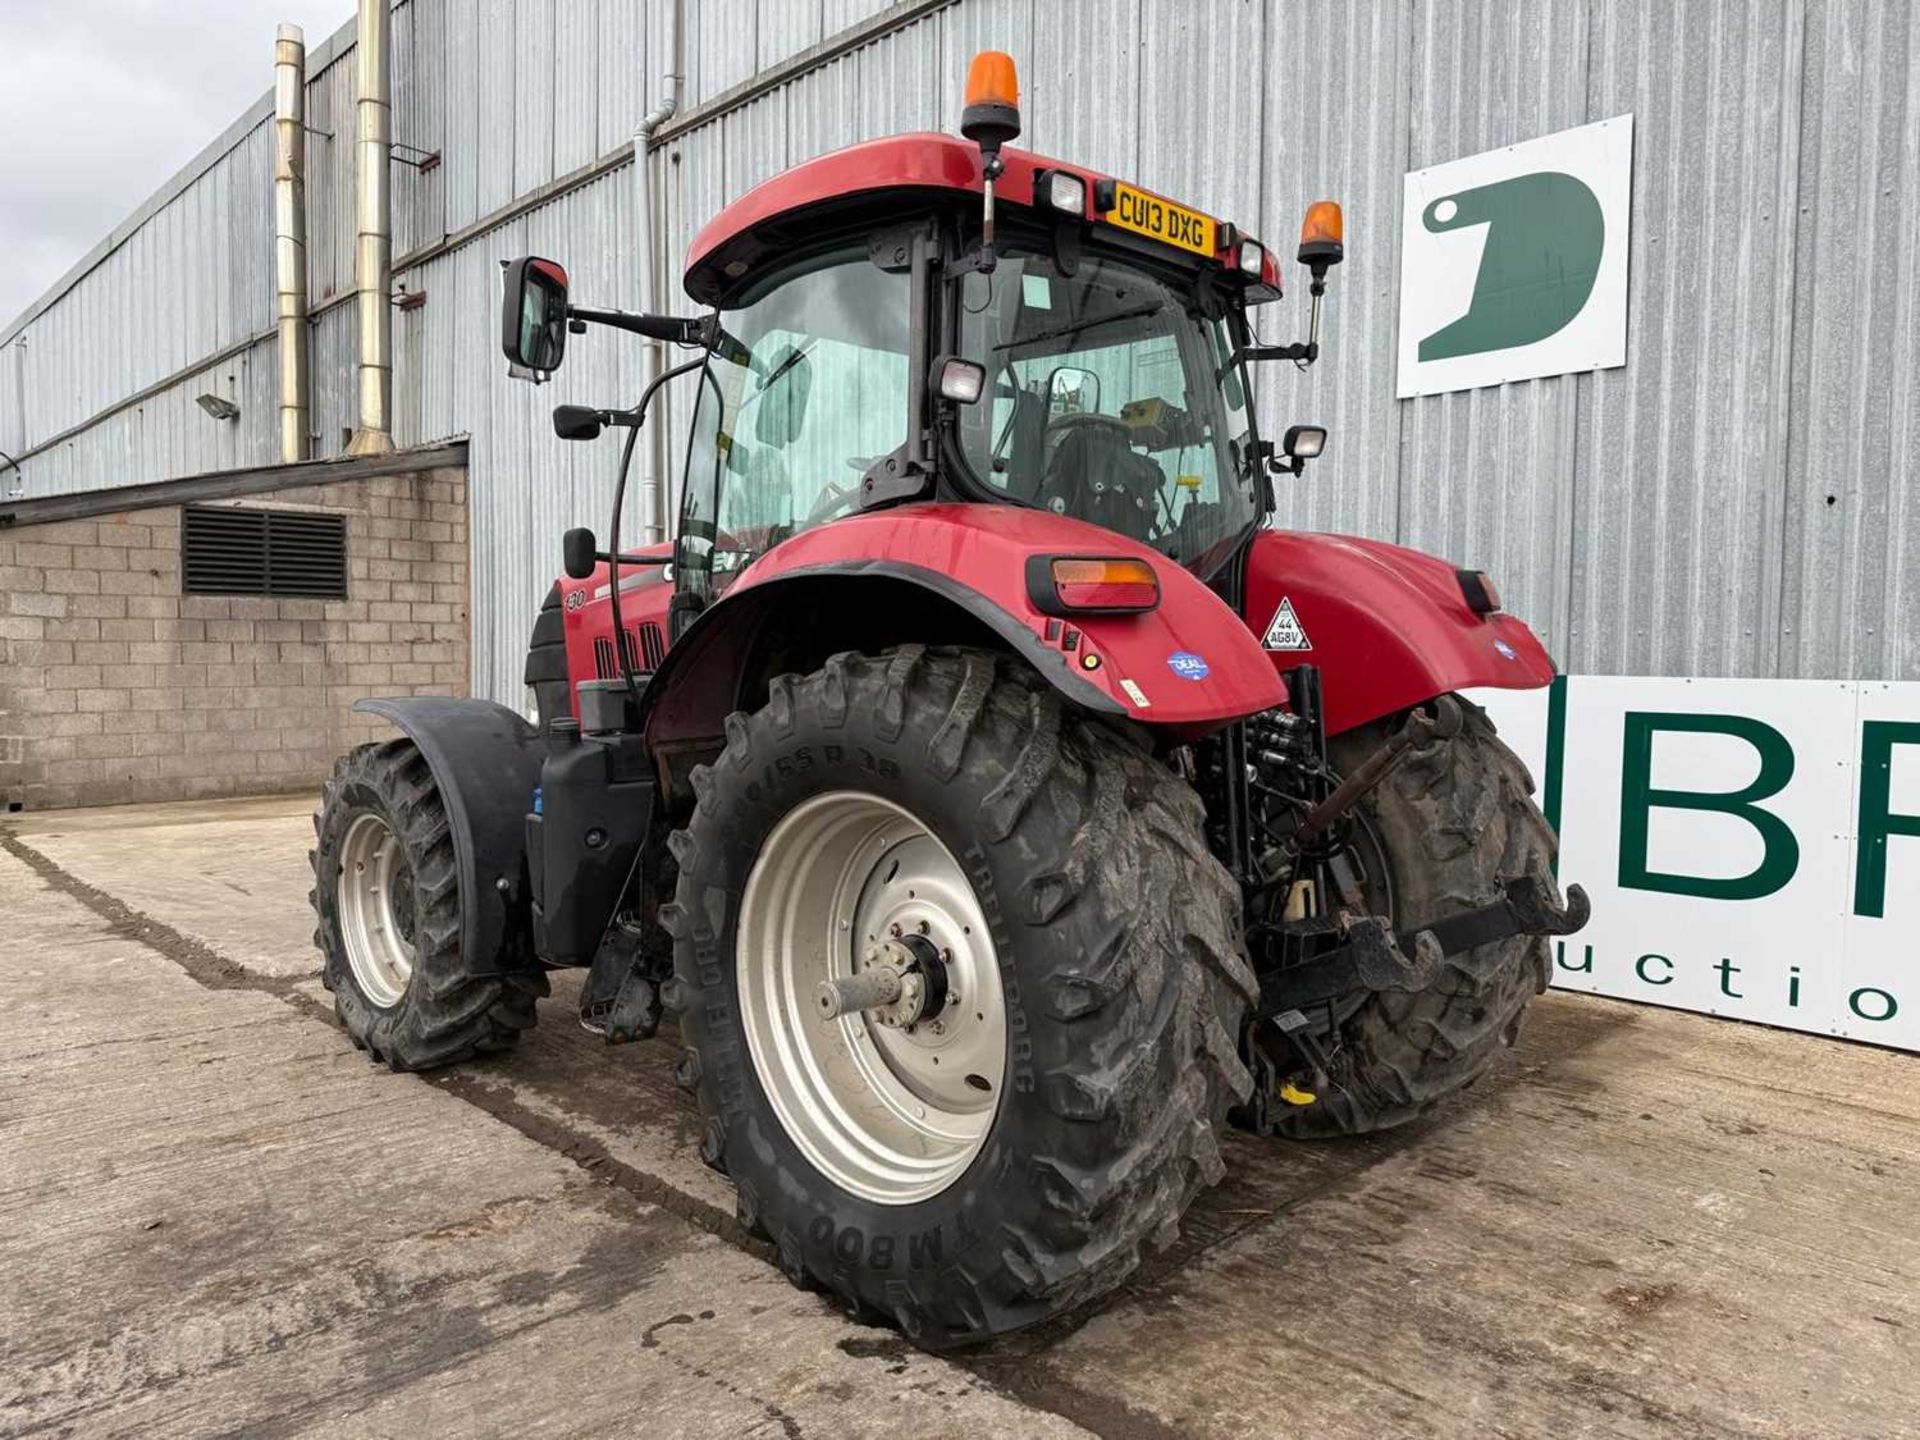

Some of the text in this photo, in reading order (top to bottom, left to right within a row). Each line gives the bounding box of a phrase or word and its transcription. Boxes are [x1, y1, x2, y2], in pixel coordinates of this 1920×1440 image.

[1119, 191, 1204, 247] CU13 DXG
[1278, 618, 1292, 629] 44
